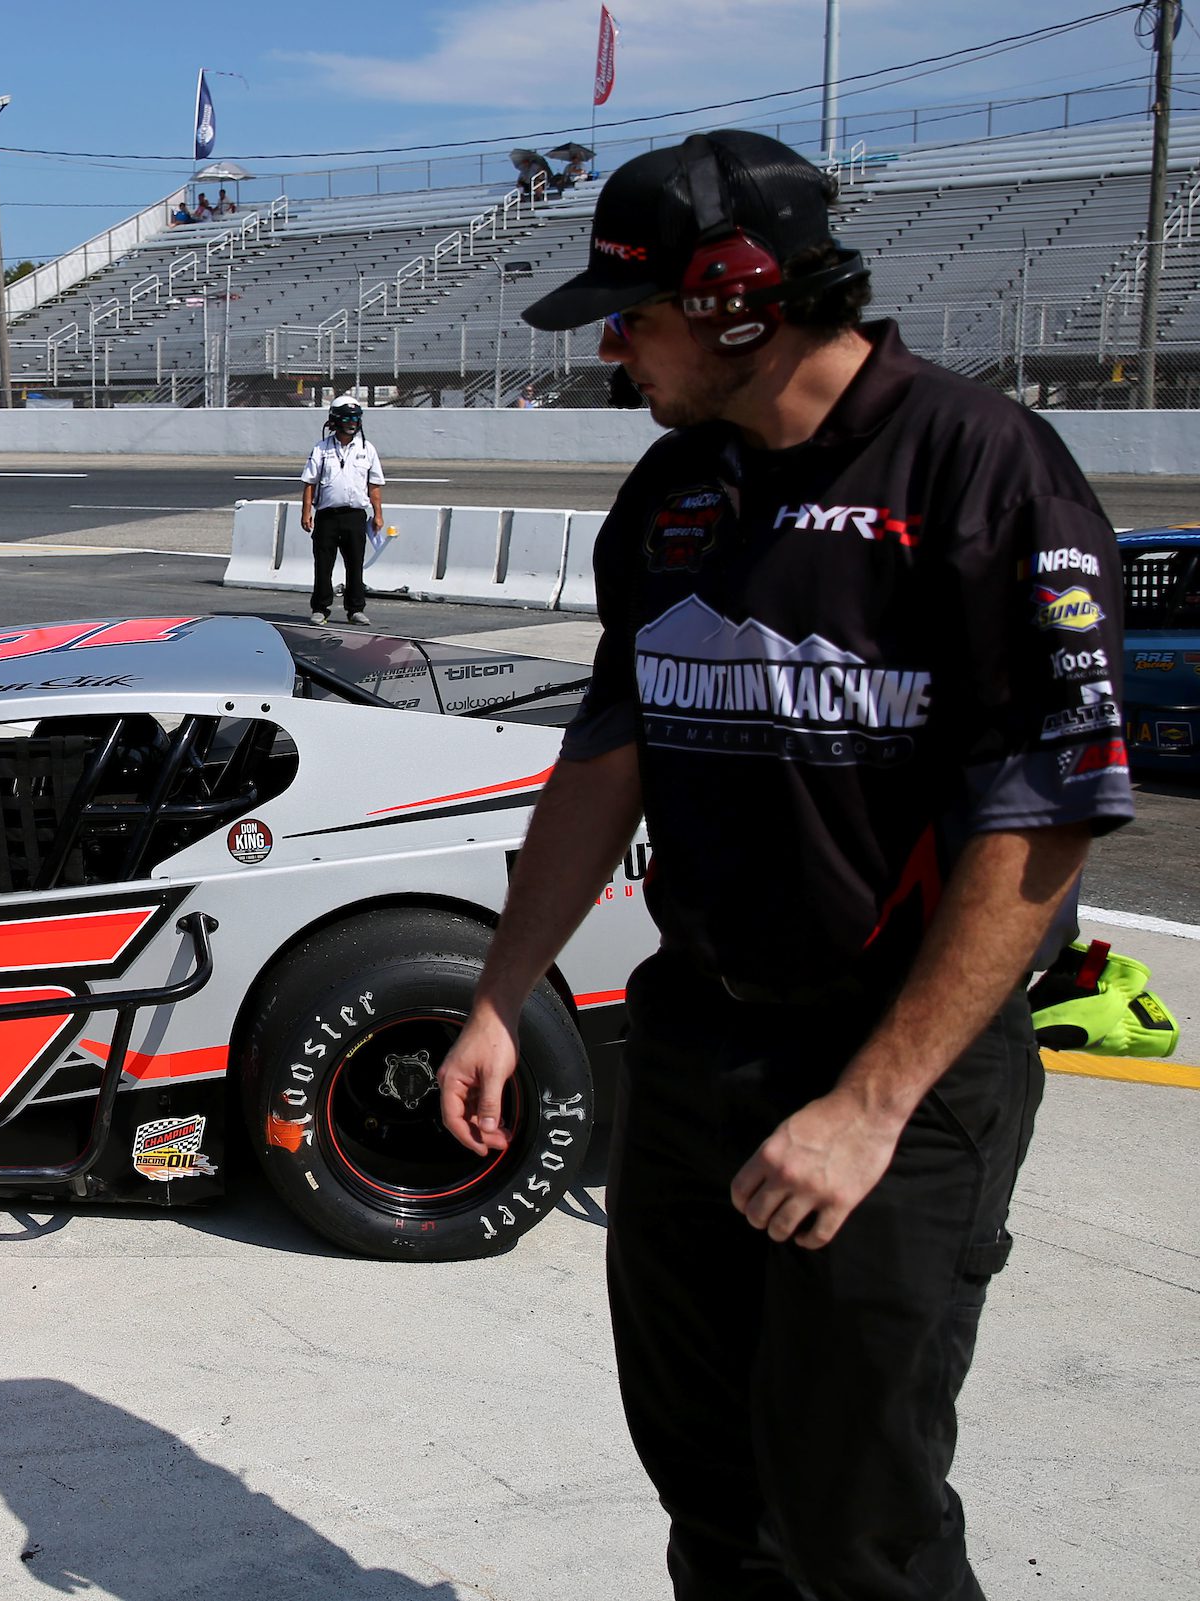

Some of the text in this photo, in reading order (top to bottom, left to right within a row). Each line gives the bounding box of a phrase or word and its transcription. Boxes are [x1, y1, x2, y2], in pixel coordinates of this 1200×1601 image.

[1037, 547, 1100, 577] NASAR
[444, 663, 514, 681] tilton
[636, 655, 933, 729] MOUNTAIN MACHINE
[241, 823, 258, 834] DON
[235, 833, 265, 850] KING
[144, 1123, 195, 1148] CHAMPION
[136, 1154, 198, 1167] Racing OIL
